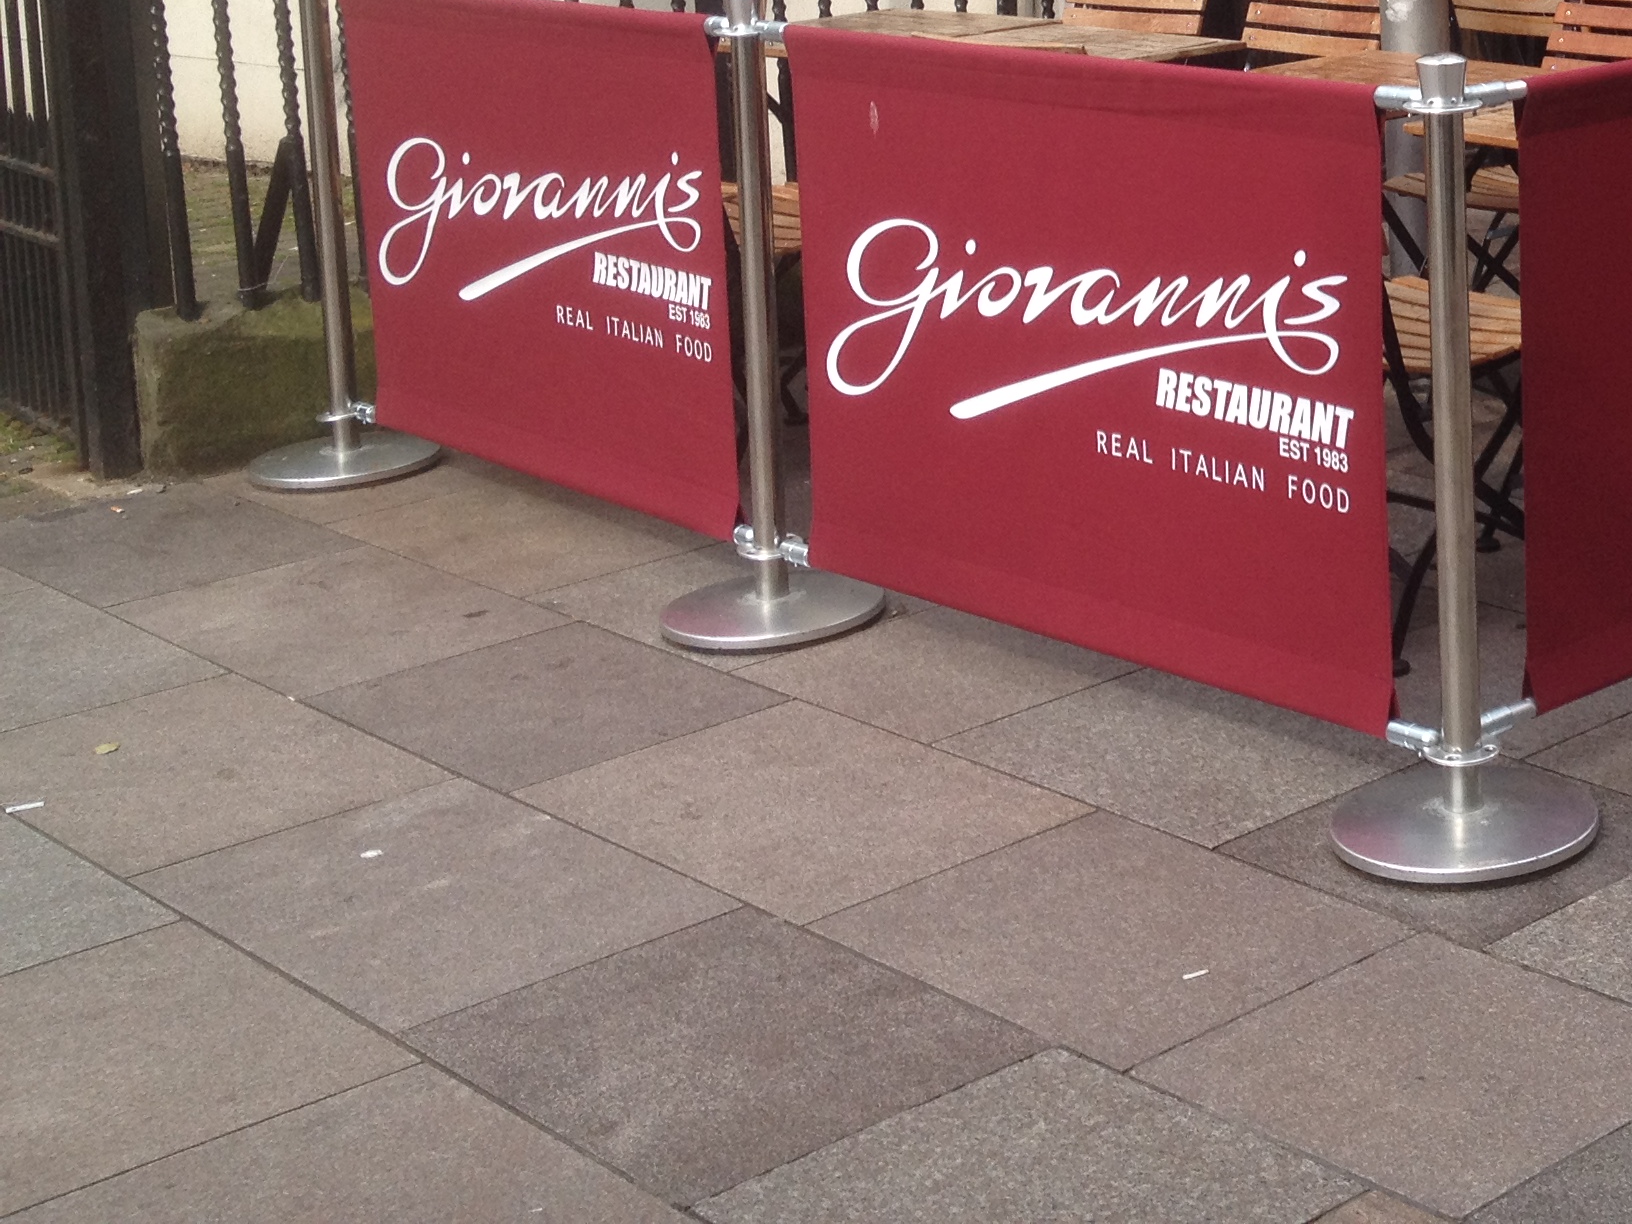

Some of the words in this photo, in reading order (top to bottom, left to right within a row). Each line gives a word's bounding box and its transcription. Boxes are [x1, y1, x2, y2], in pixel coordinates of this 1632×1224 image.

[592, 251, 712, 310] RESTAURANT
[556, 305, 594, 331] REAL
[606, 315, 664, 349] ITALIAN
[676, 334, 713, 363] FOOD
[668, 304, 687, 324] EST
[689, 309, 711, 330] 1983
[1155, 367, 1355, 449] RESTAURANT
[1096, 430, 1153, 464] REAL
[1171, 448, 1266, 492] ITALIAN
[1287, 475, 1351, 514] FOOD
[1279, 436, 1312, 463] EST
[1315, 444, 1349, 473] 1983
